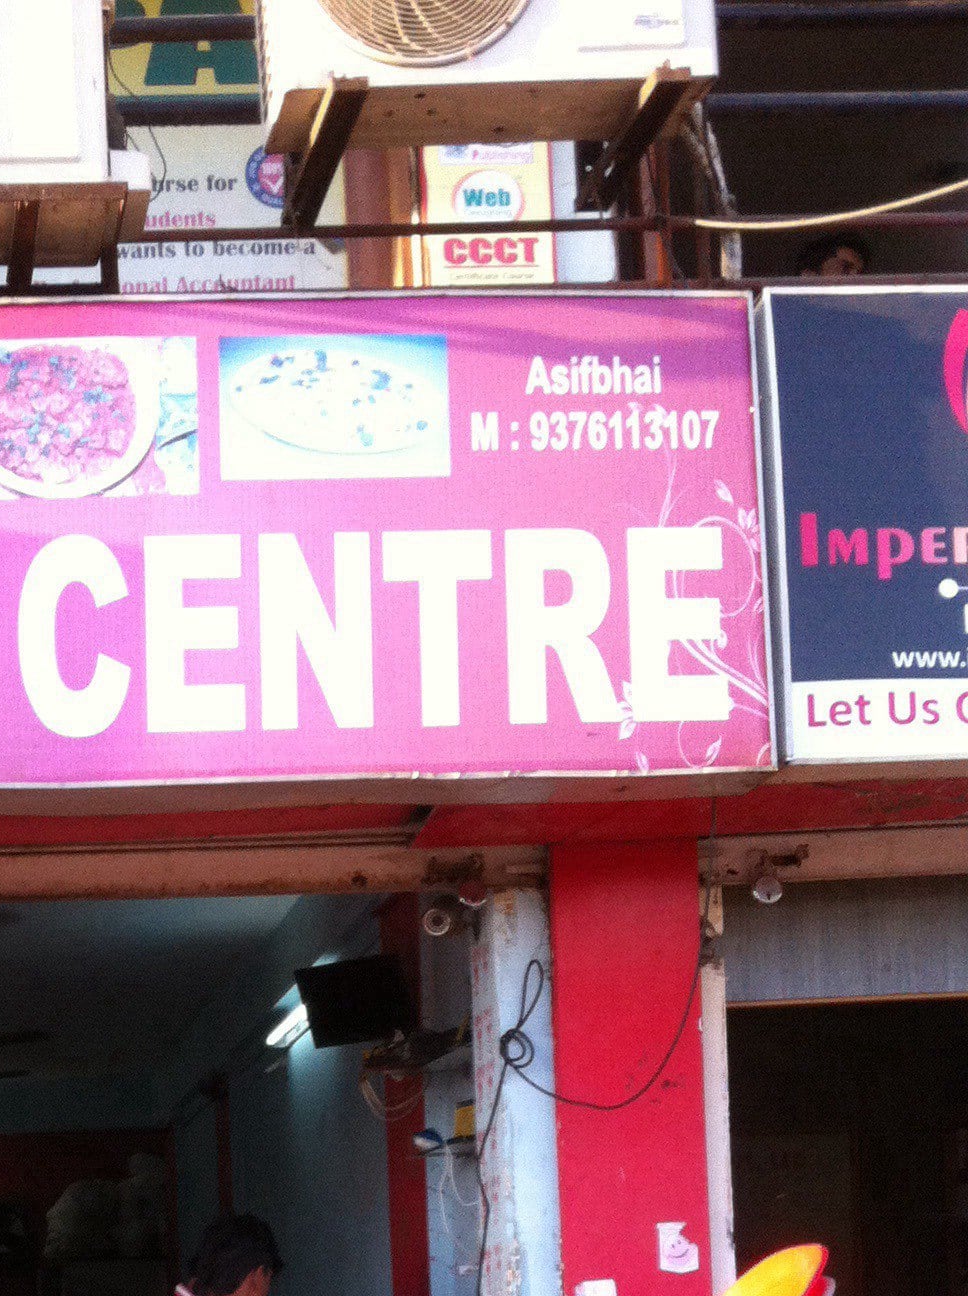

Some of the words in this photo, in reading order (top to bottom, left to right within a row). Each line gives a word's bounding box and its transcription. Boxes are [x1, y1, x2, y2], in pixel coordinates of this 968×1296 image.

[206, 174, 238, 192] for
[463, 187, 511, 207] Web
[213, 239, 296, 257] become
[443, 237, 540, 265] CCCT
[525, 355, 663, 396] Asifbhai
[529, 410, 720, 451] 9376113107
[17, 526, 731, 739] CENTRE
[807, 693, 872, 728] Let
[888, 690, 941, 726] Us
